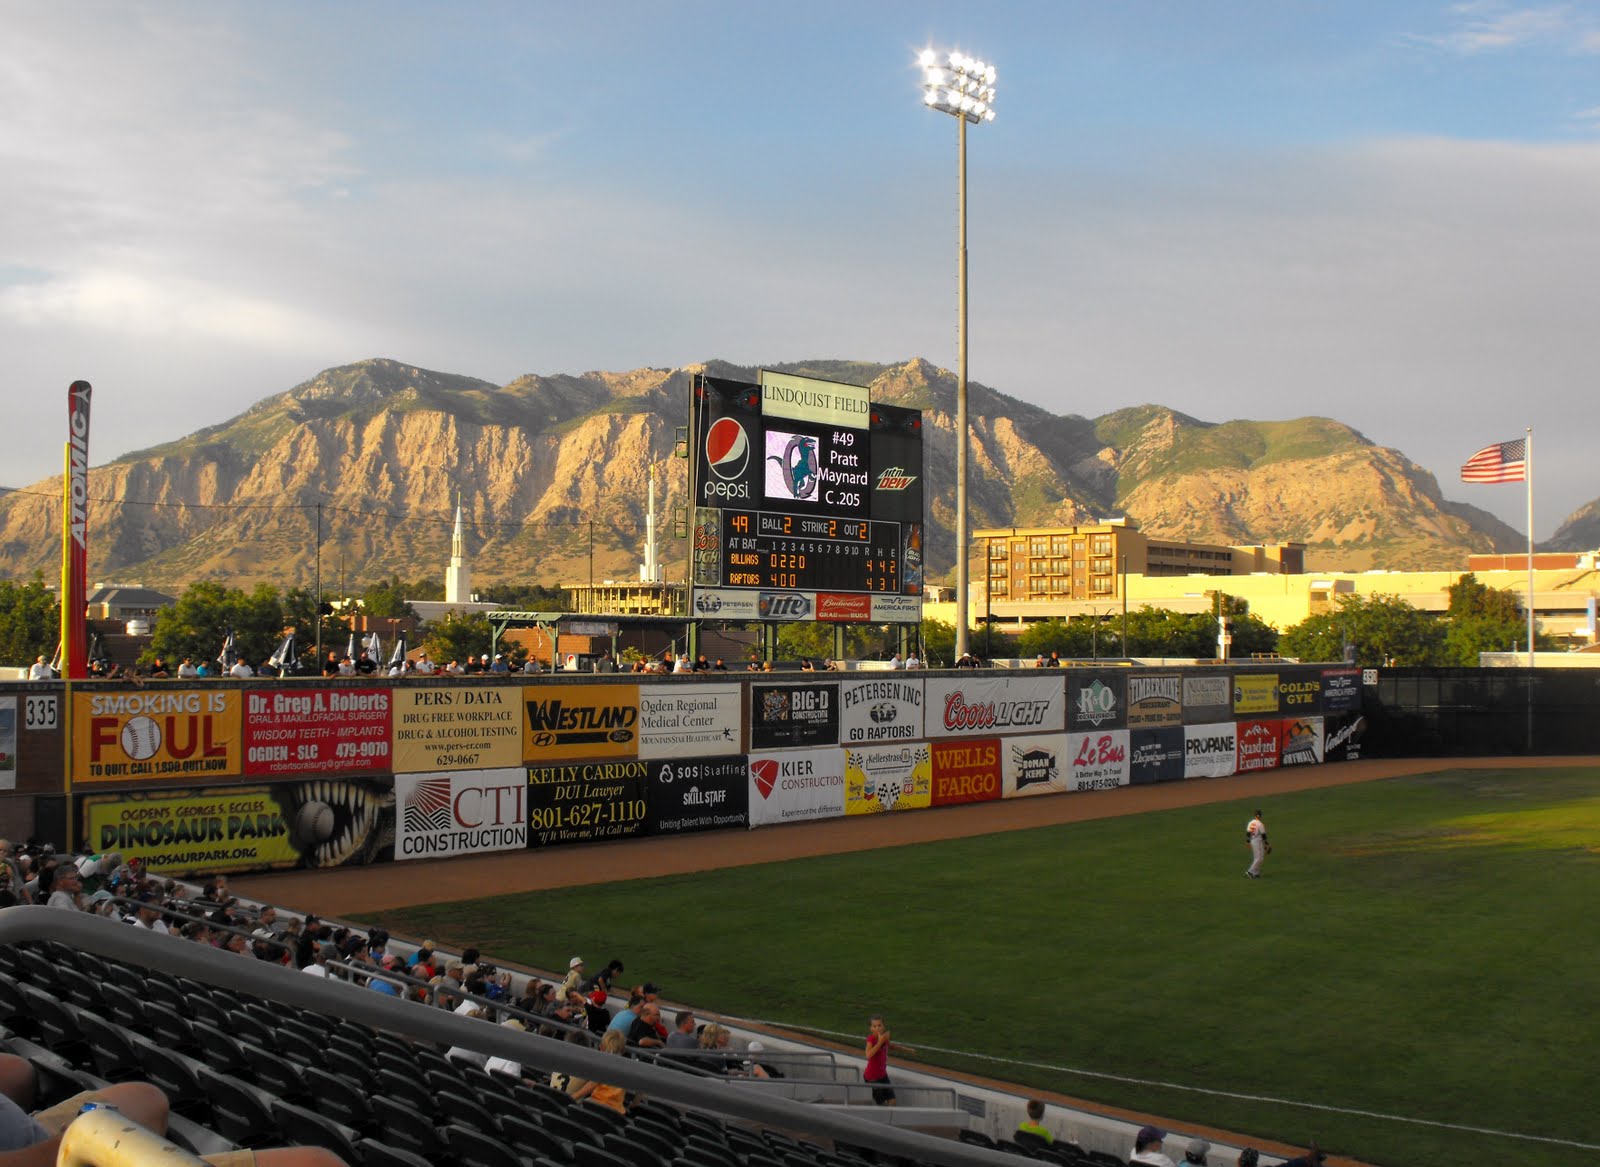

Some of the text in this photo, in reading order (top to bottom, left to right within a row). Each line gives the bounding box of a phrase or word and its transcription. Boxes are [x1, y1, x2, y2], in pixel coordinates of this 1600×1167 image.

[764, 385, 868, 414] LINDQUIST FIELD
[832, 432, 854, 446] #49
[830, 451, 858, 467] Pratt
[71, 411, 87, 550] ATOMIC
[819, 468, 868, 485] Maynard
[704, 481, 748, 500] pepsi
[825, 491, 860, 506] C .205
[732, 516, 749, 533] 49
[762, 517, 791, 533] BALL 2
[801, 520, 837, 537] STRIKE 2
[844, 523, 867, 539] OUT 2
[729, 537, 757, 550] AT BAT
[772, 541, 776, 551] 1
[781, 542, 786, 551] 2
[790, 543, 796, 551] 3
[799, 543, 805, 552] 4
[809, 544, 814, 552] 5
[818, 544, 823, 553] 6
[826, 545, 831, 554] 7
[835, 545, 840, 554] 8
[844, 546, 849, 555] 9
[851, 546, 859, 555] 10
[865, 547, 870, 556] R
[877, 548, 883, 557] H
[891, 549, 896, 558] E
[730, 553, 896, 574] BILLINGS 0 2 2 0 4 4 2
[730, 573, 760, 585] RAPTORS
[771, 574, 777, 586] 4
[780, 574, 787, 587] 0
[790, 574, 796, 587] 0
[866, 578, 873, 591] 4
[879, 578, 885, 591] 3
[768, 595, 803, 616] Lite
[823, 599, 864, 609] Budweiser
[844, 682, 921, 709] PETERSEN INC
[1279, 681, 1320, 694] GOLD'S
[91, 693, 226, 715] SMOKING IS
[248, 692, 388, 715] Dr. Greg A. Roberts
[414, 691, 502, 706] PERS / DATA
[641, 698, 717, 715] Ogden Regional
[792, 690, 829, 711] BIG-D
[1287, 694, 1313, 705] GYM
[26, 700, 56, 726] 335
[249, 712, 387, 724] ORAL & MAXILLOFACIAL SURGERY
[403, 711, 513, 723] DRUG FREE WORKPLACE
[526, 699, 638, 731] WESTLAND
[943, 691, 1050, 731] Coors LIGHT
[641, 715, 714, 728] Medical Center
[91, 715, 227, 762] FOUL
[253, 726, 384, 740] WISDOM TEETH IMPLANTS
[397, 726, 518, 740] DRUG & ALCOHOL TESTING
[850, 725, 915, 740] GO RAPTORS!
[248, 741, 388, 762] OGDEN SLC 479-9070
[1186, 736, 1235, 755] PROPANE
[436, 754, 480, 766] 629-0667
[936, 747, 996, 770] WELLS
[1023, 759, 1049, 769] BOMAN
[1239, 755, 1277, 770] Examiner
[90, 765, 102, 776] TO
[131, 762, 153, 774] CALL
[528, 762, 648, 785] KELLY CARDON
[677, 764, 746, 779] SOS Staffing
[781, 760, 813, 777] KIER
[1025, 769, 1046, 779] KEMP
[781, 775, 844, 790] CONSTRUCTION
[938, 774, 996, 798] FARGO
[554, 784, 625, 801] DUI Lawyer
[683, 790, 726, 807] SKILL STAFF
[121, 801, 264, 821] OGDEN'S GEORGE S. ECCLES
[453, 785, 526, 829] CTI
[531, 799, 646, 830] 801-627-1110
[781, 806, 817, 818] Experience the
[660, 814, 746, 830] Uniting Talent With Opportunity
[100, 813, 286, 850] DINOSAUR PARK
[550, 831, 557, 841] It
[559, 830, 577, 839] Were
[607, 825, 622, 835] Call
[403, 827, 526, 854] CONSTRUCTION
